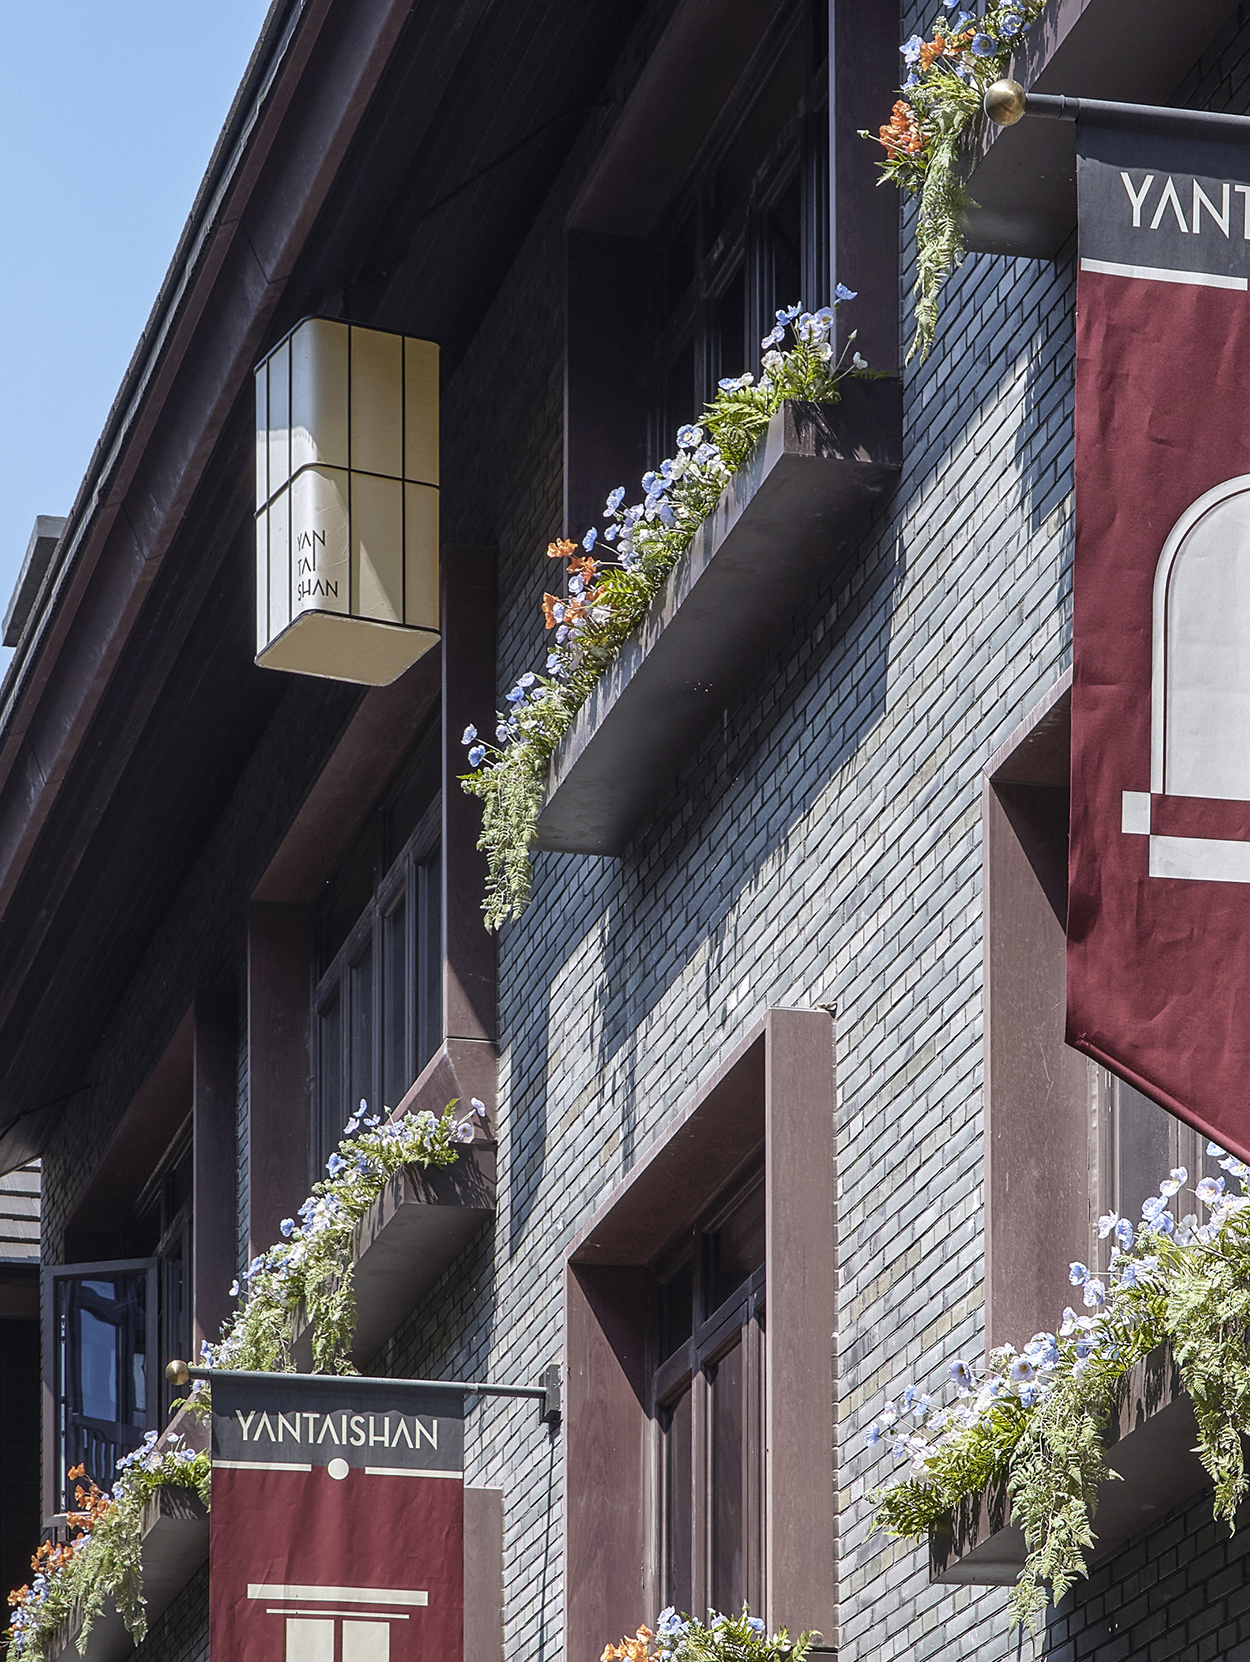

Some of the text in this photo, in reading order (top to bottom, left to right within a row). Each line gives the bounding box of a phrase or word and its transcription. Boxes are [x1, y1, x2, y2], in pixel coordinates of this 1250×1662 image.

[296, 529, 326, 552] YAN
[297, 578, 338, 602] SHAN
[235, 1409, 439, 1451] YANTAISHAN
